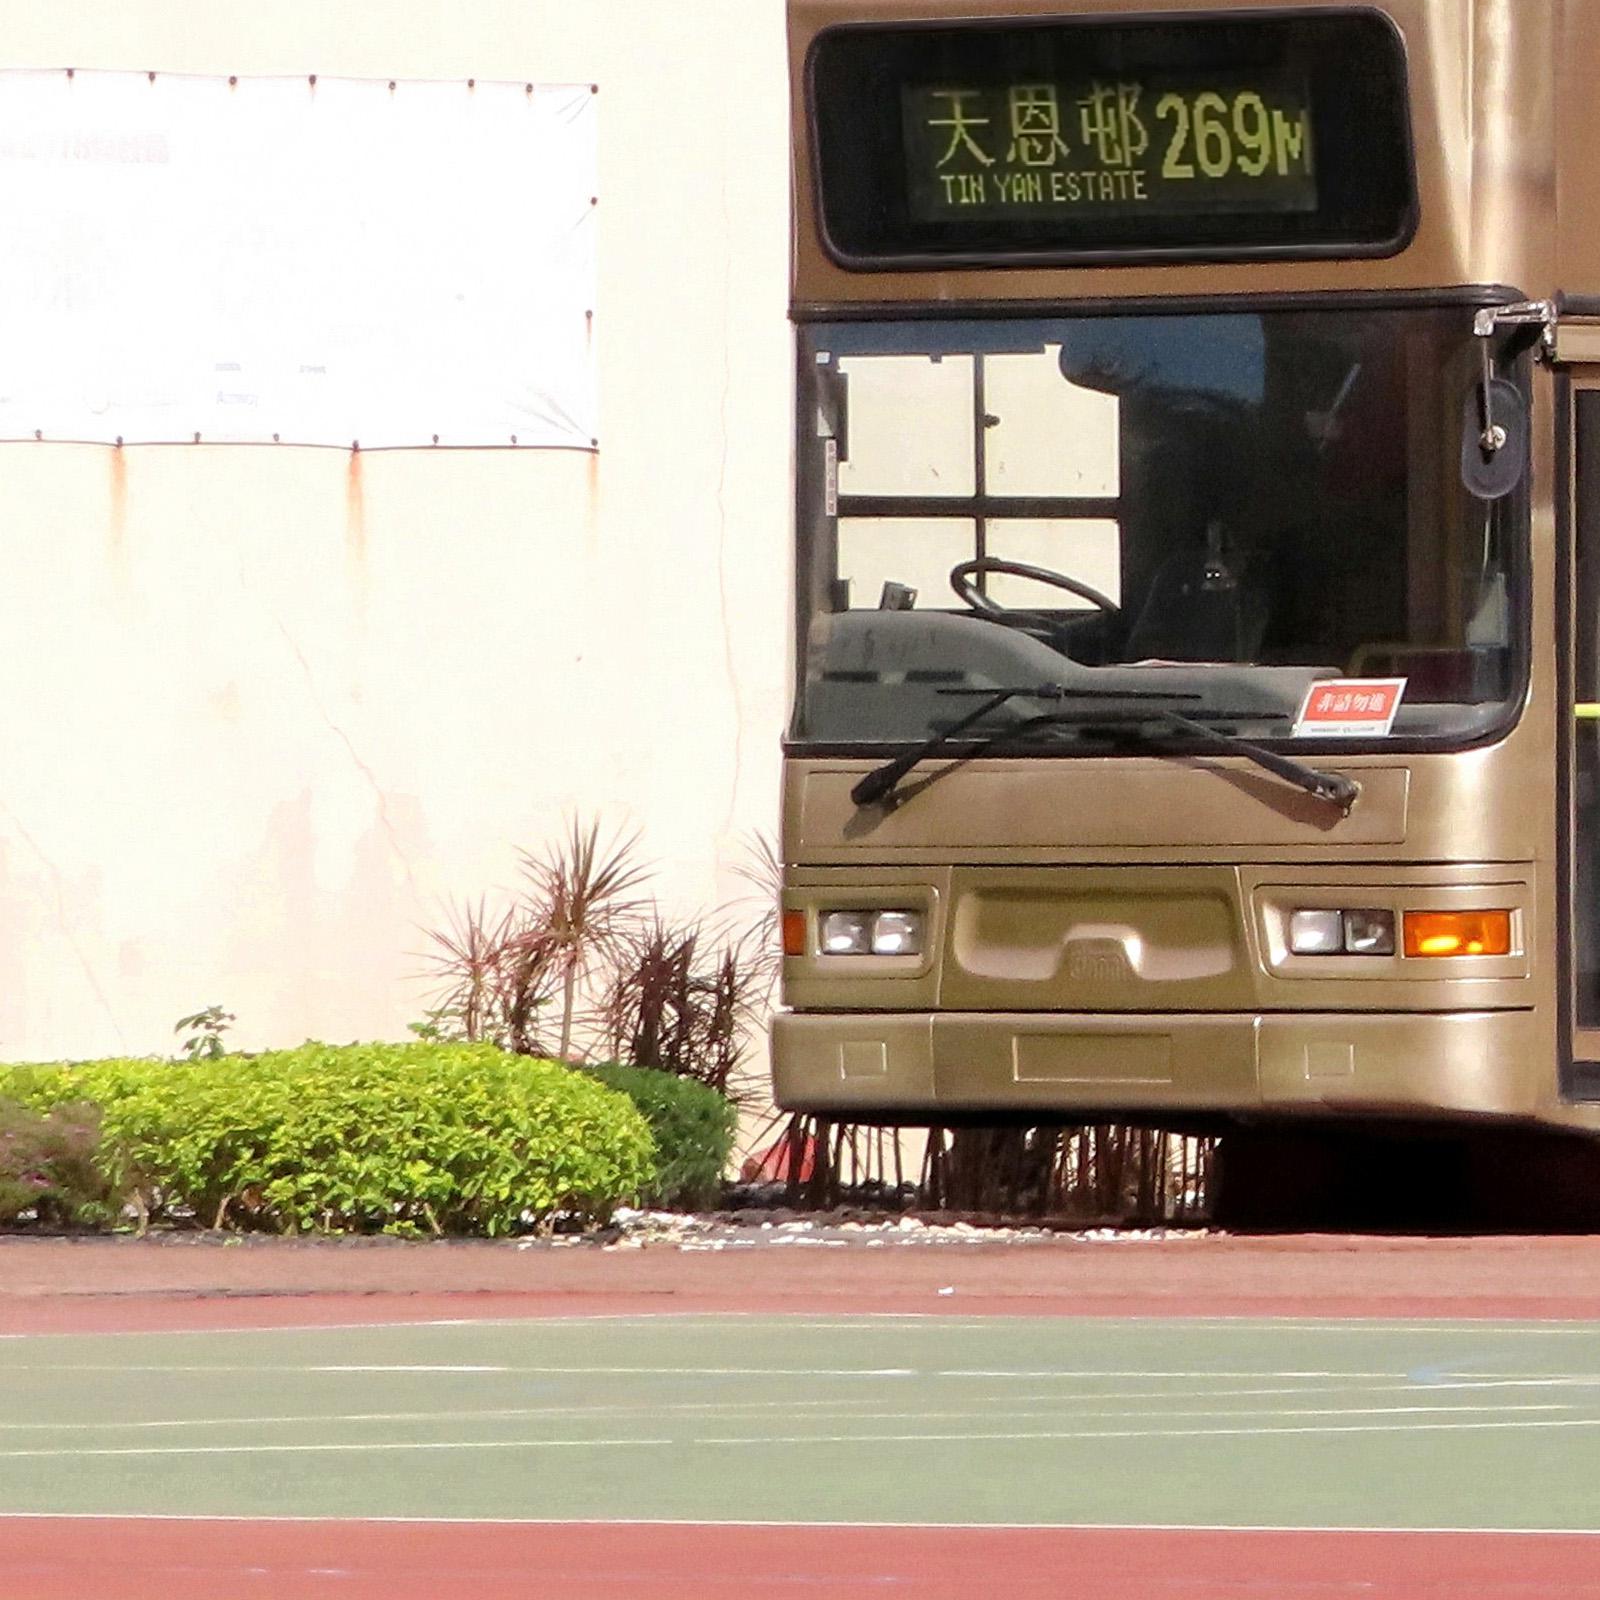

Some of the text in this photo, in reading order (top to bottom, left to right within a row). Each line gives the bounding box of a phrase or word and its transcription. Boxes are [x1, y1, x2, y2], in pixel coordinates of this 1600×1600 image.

[927, 82, 1149, 169] 天恩邨
[1155, 91, 1312, 179] 269M
[939, 170, 1149, 204] TIN YAN ESTATE
